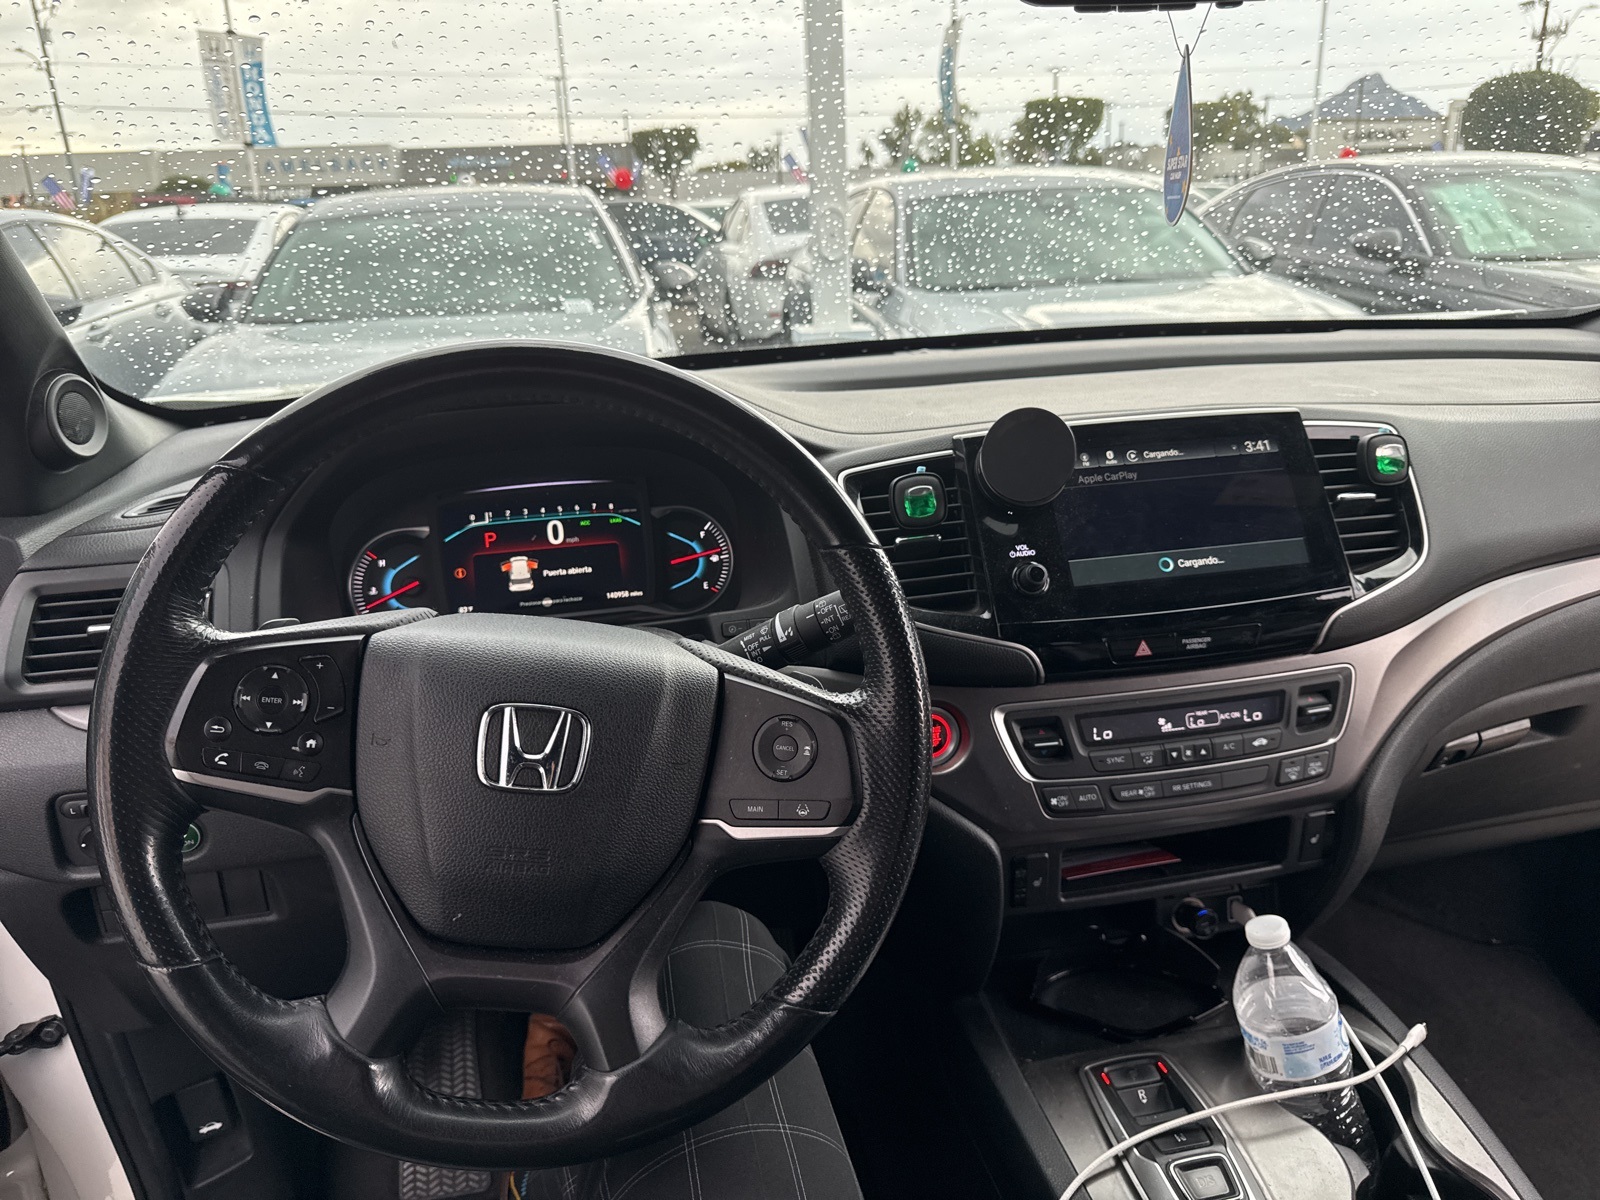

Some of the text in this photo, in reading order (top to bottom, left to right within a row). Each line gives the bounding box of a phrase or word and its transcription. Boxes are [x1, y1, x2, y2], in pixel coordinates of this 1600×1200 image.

[1178, 155, 1188, 169] STAR
[1244, 440, 1270, 453] 3:41
[1078, 471, 1137, 484] Apple CarPlay
[546, 520, 580, 545] 0 mph
[484, 532, 497, 548] P
[1016, 549, 1036, 557] AUDIO
[543, 566, 592, 577] Puerta abierta
[703, 581, 709, 589] E
[820, 604, 833, 614] OFF
[829, 625, 840, 634] ON
[743, 632, 755, 641] MIST
[759, 634, 772, 643] PULL
[747, 641, 759, 651] OFF
[751, 648, 762, 657] INT
[261, 696, 283, 704] ENTER
[775, 744, 795, 752] CANCEL
[1106, 756, 1125, 764] SYNC
[1183, 780, 1212, 790] SETTINGS
[1121, 789, 1138, 797] REAR
[1079, 794, 1097, 802] AUTO
[1137, 1089, 1147, 1101] R
